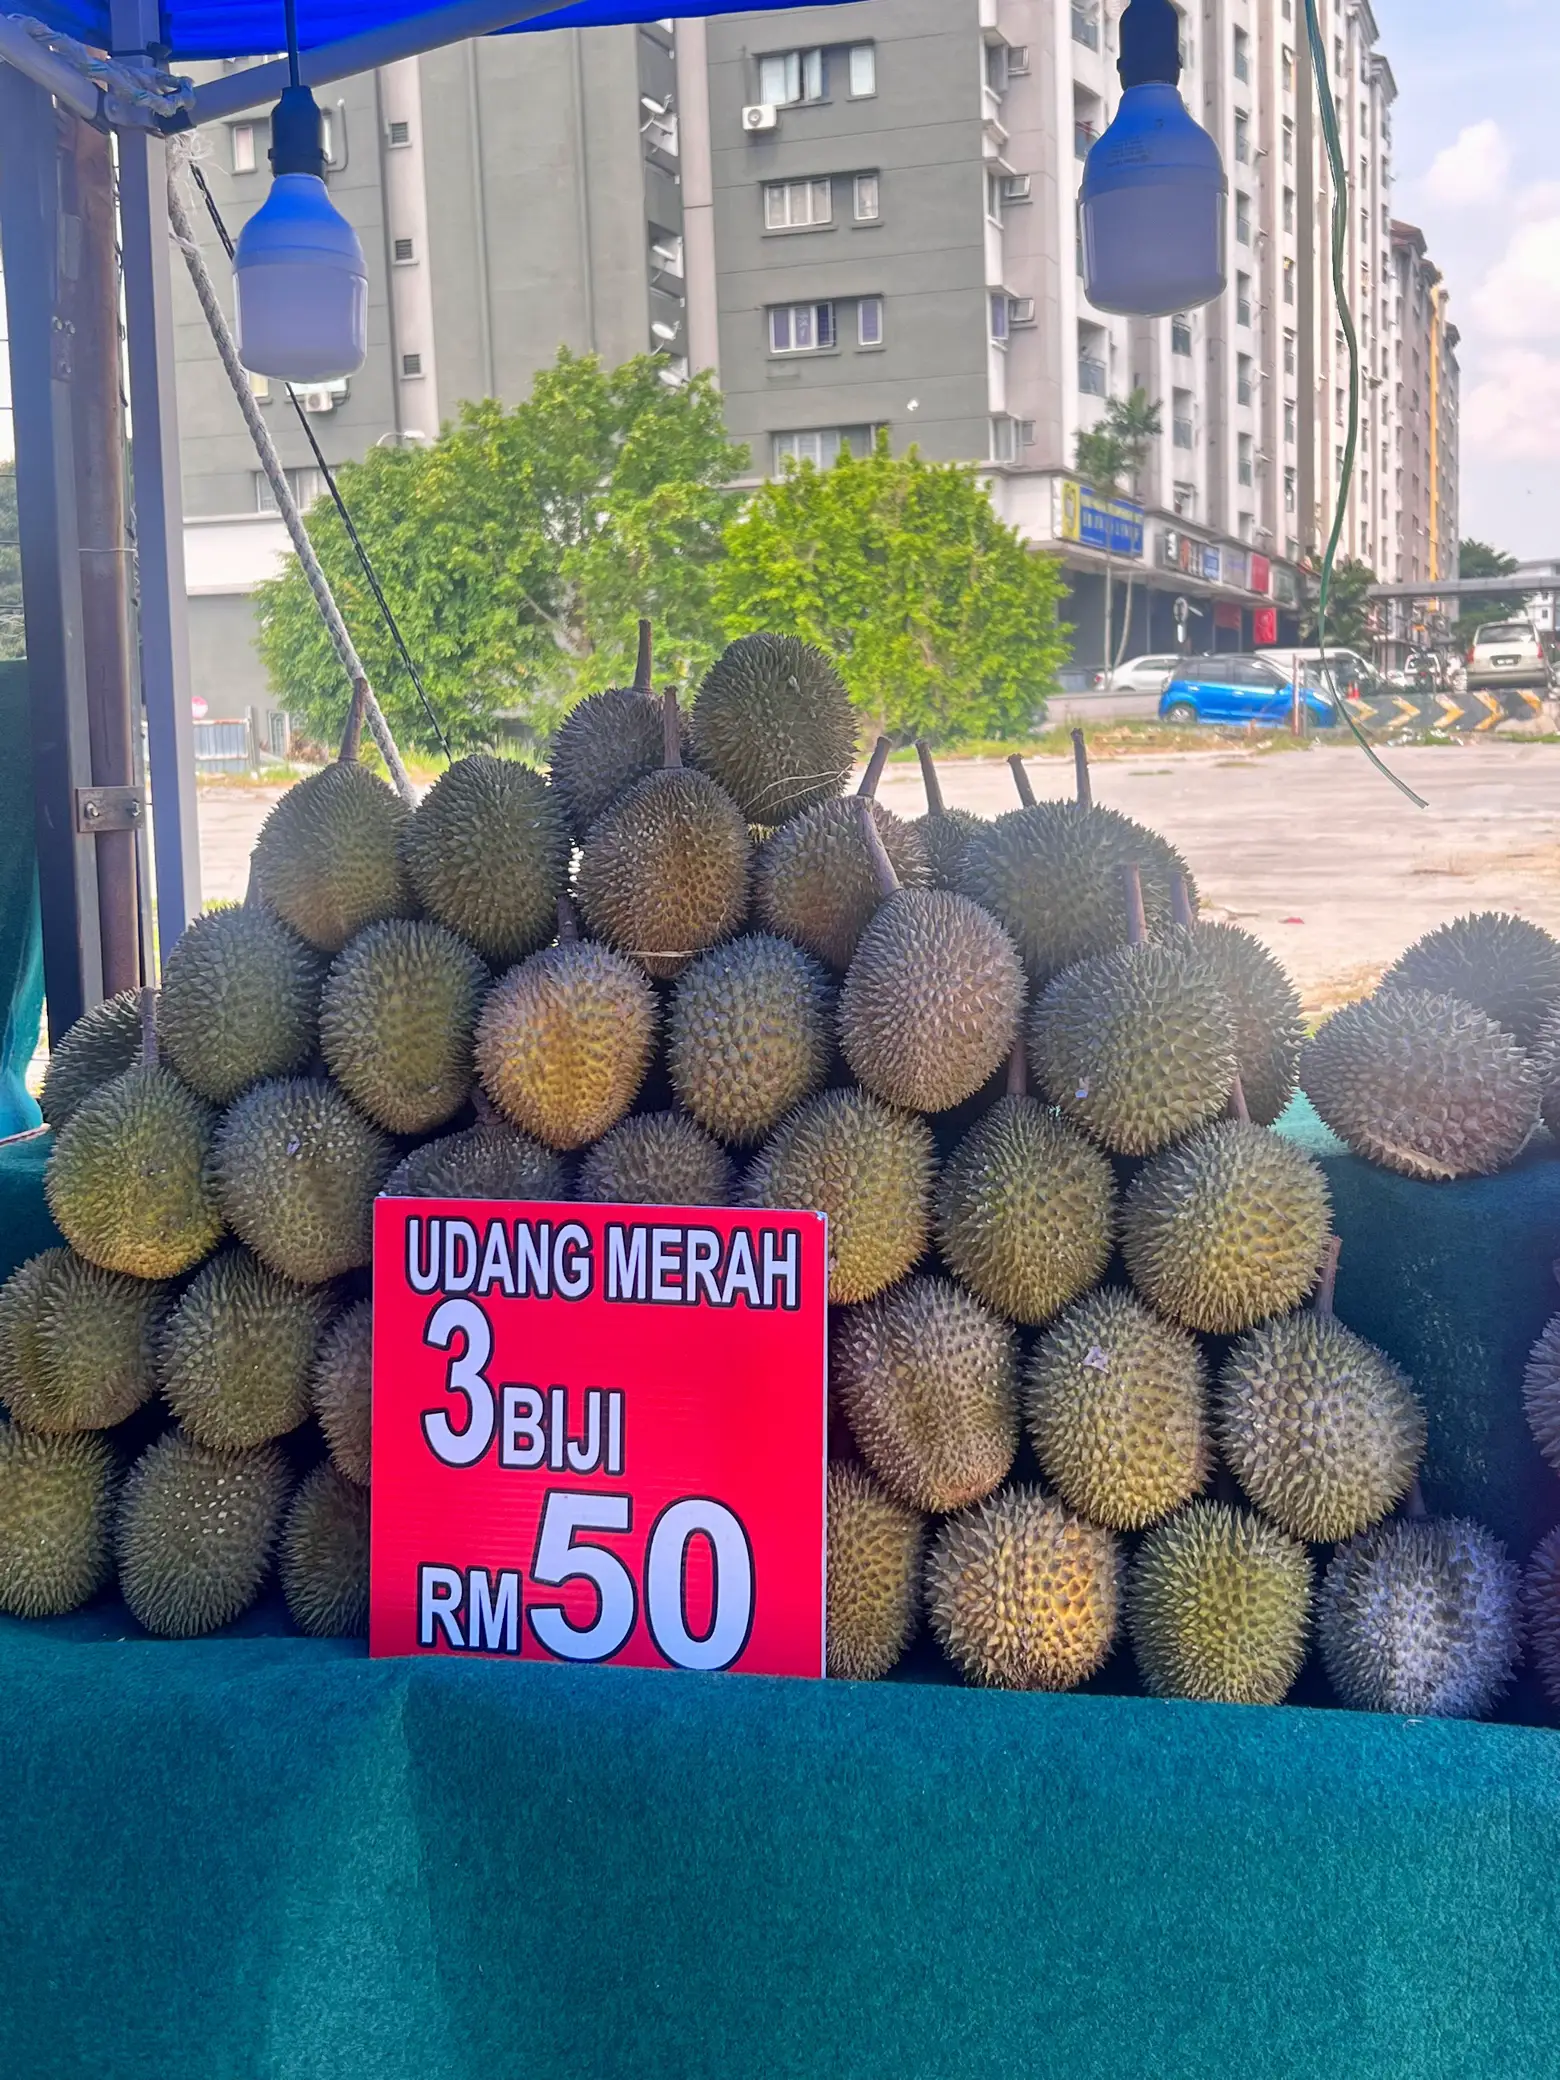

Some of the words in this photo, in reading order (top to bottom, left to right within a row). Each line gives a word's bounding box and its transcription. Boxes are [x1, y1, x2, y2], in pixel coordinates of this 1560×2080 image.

[405, 1215, 593, 1299] UDANG
[604, 1222, 801, 1310] MERAH
[421, 1295, 496, 1468] 3
[499, 1383, 626, 1476] BIJI
